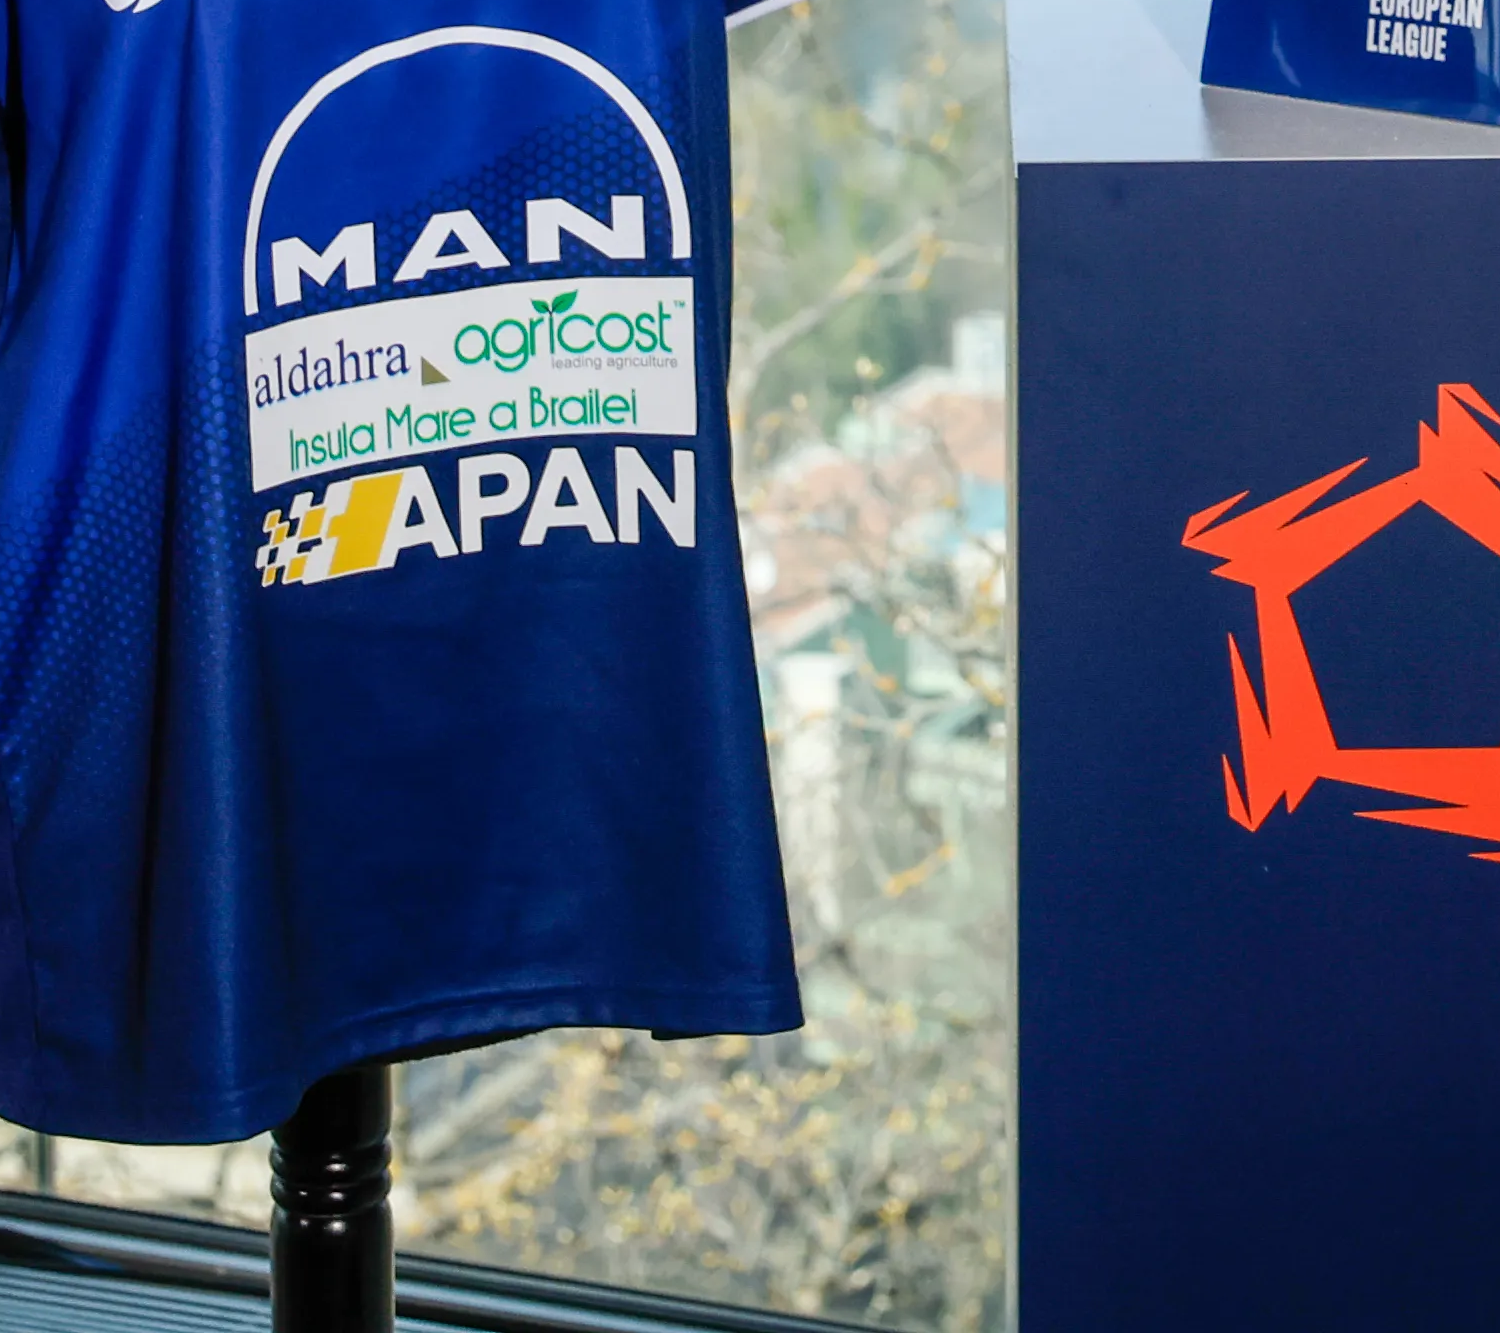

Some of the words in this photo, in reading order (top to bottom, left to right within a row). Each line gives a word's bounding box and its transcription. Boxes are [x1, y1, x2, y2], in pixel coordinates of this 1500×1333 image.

[1366, 17, 1448, 62] LEAGUE
[271, 195, 646, 306] MAN
[453, 290, 673, 373] agricost
[552, 354, 602, 370] leading
[606, 353, 678, 370] agriculture
[290, 422, 375, 471] Insula
[386, 403, 476, 449] Mare
[489, 400, 517, 431] a
[529, 386, 637, 429] Brailei
[376, 446, 697, 569] APAN
